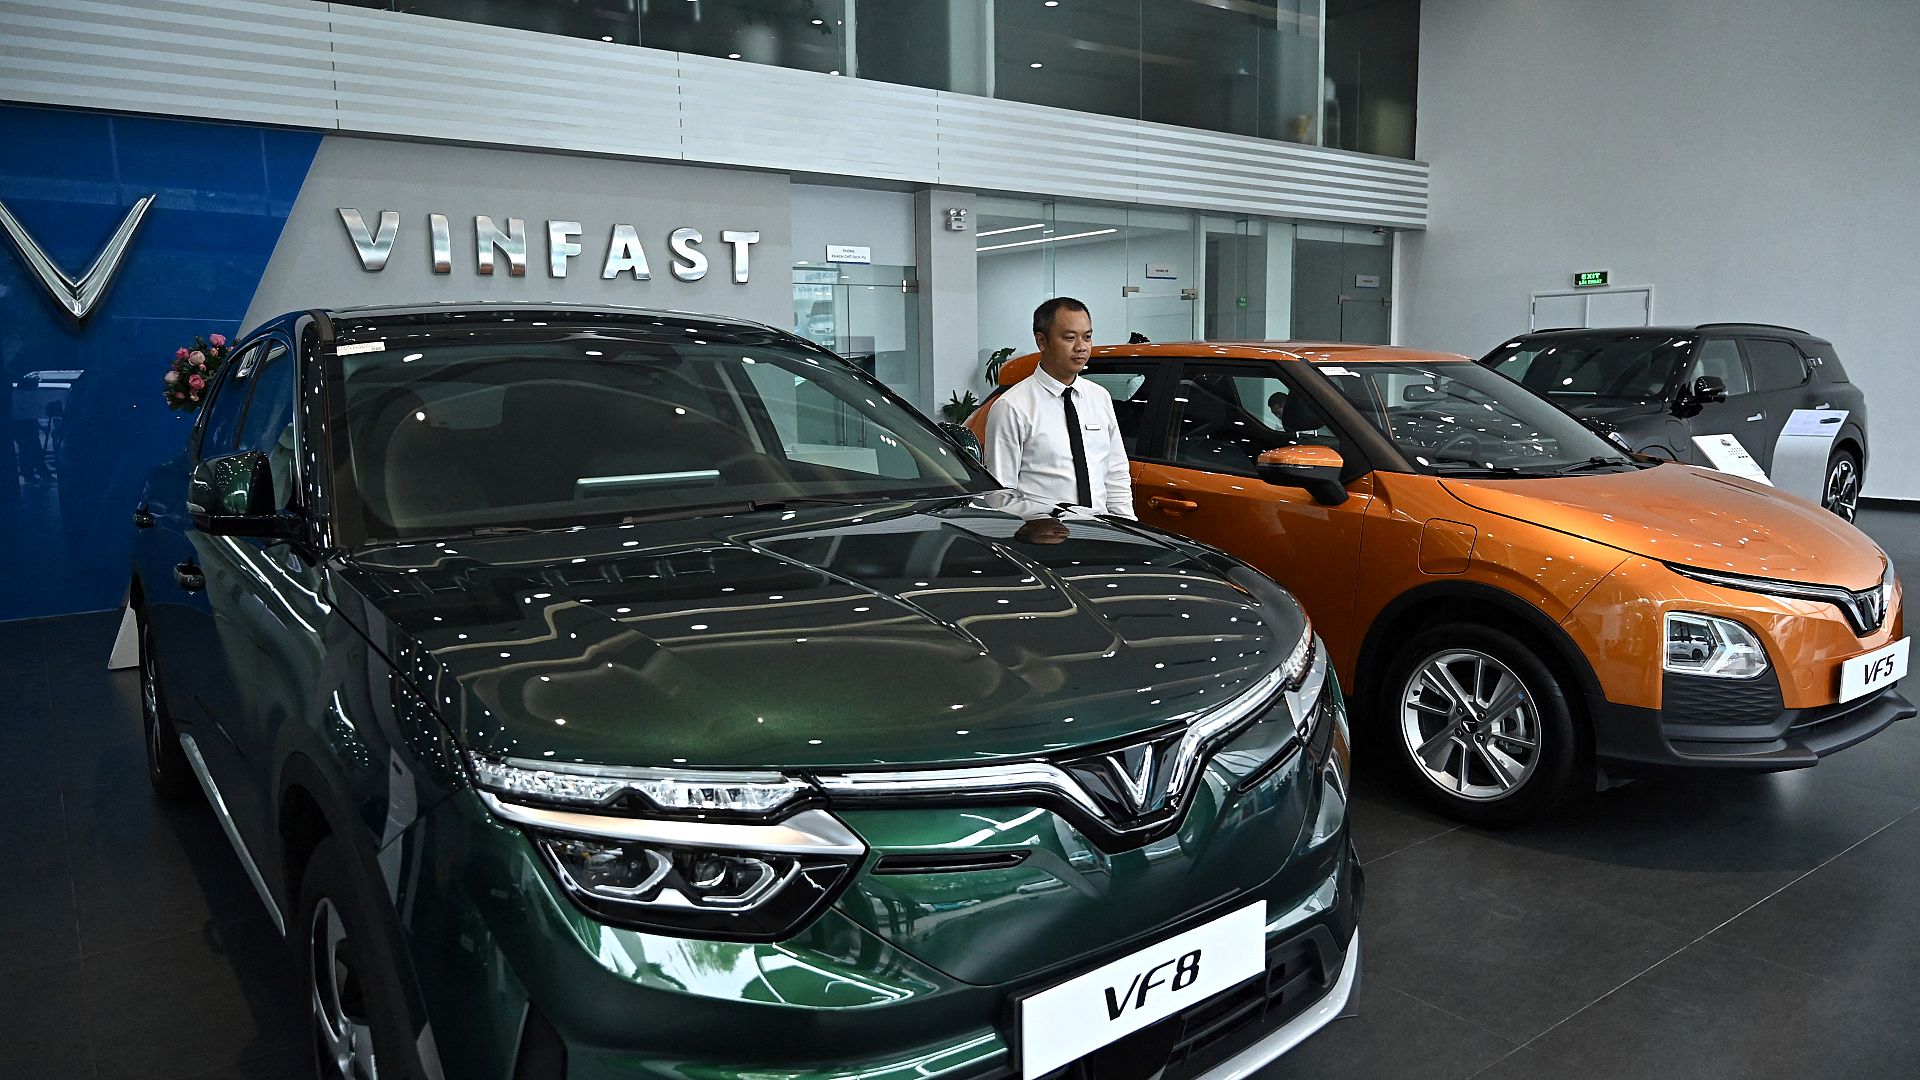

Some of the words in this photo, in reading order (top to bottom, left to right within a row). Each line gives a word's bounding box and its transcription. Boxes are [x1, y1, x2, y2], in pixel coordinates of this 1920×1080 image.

[337, 207, 760, 285] VINFAST
[1864, 653, 1896, 685] VF5
[1104, 948, 1202, 1021] VF8
